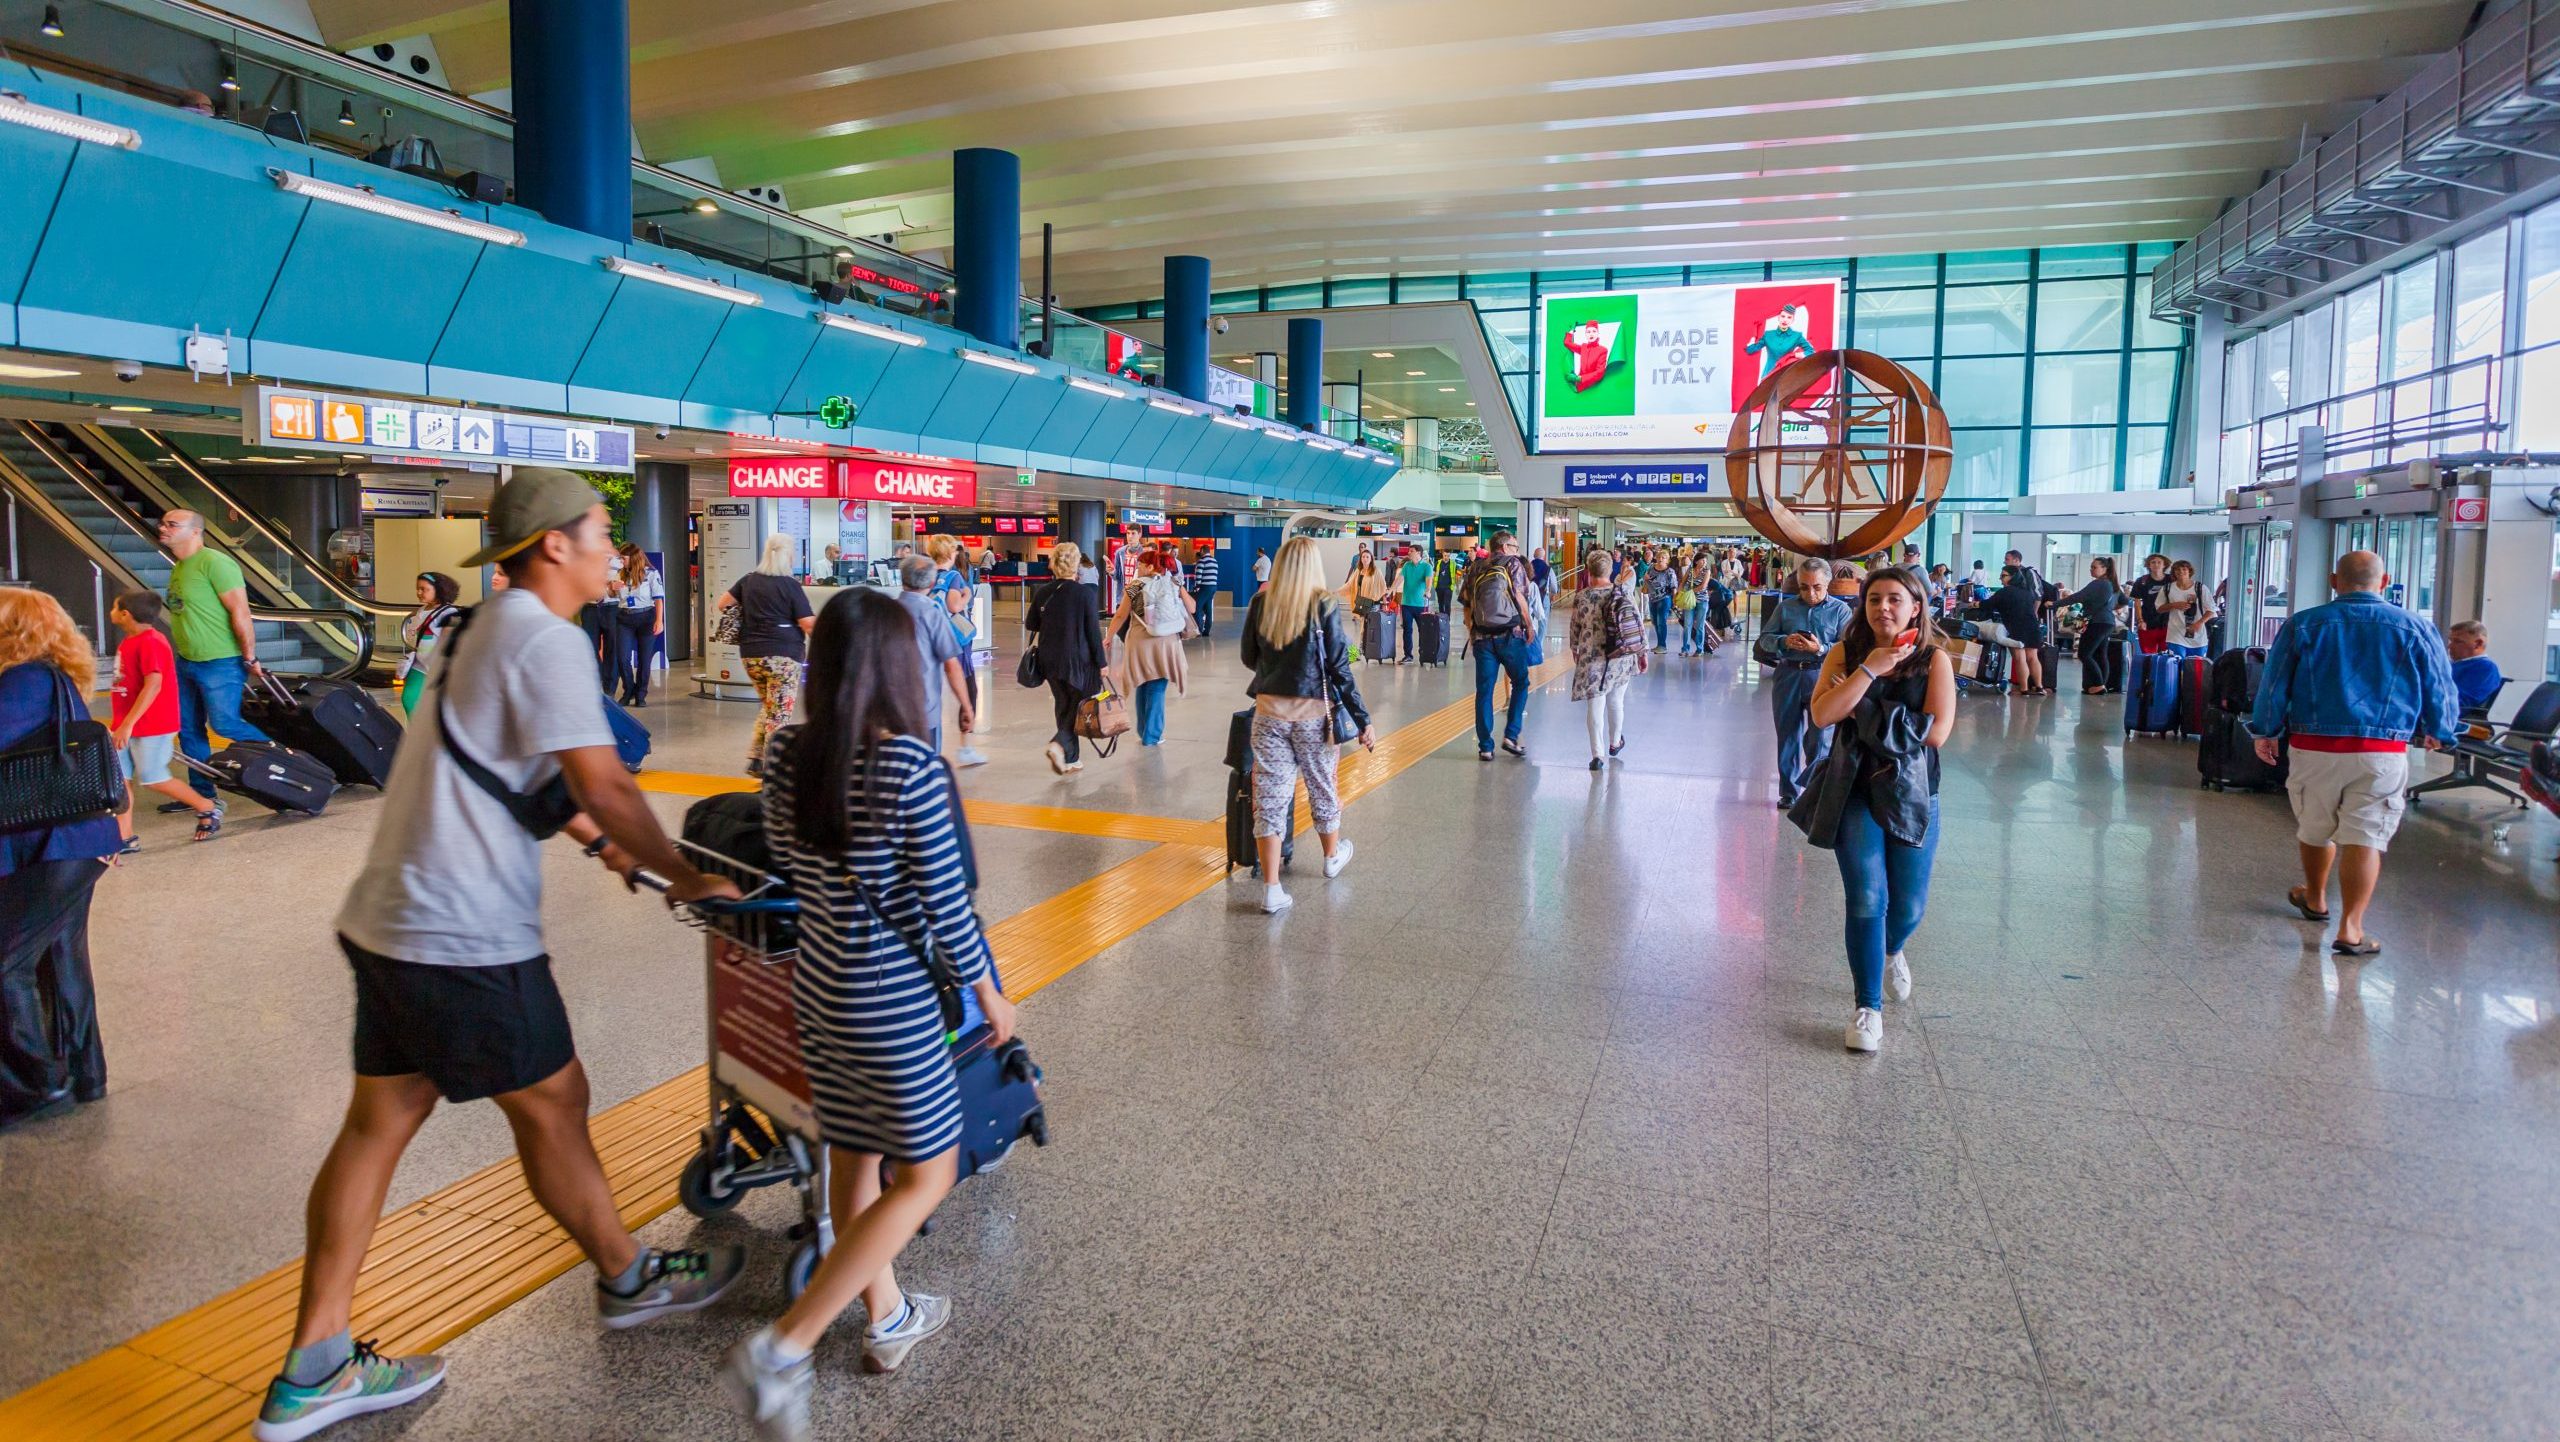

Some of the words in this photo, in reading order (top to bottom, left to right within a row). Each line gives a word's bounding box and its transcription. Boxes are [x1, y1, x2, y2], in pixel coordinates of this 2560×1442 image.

[1650, 327, 1719, 347] MADE
[1668, 347, 1699, 366] OF
[1652, 366, 1716, 385] ITALY
[1209, 380, 1243, 395] ATI
[733, 467, 825, 488] CHANGE
[875, 469, 954, 498] CHANGE
